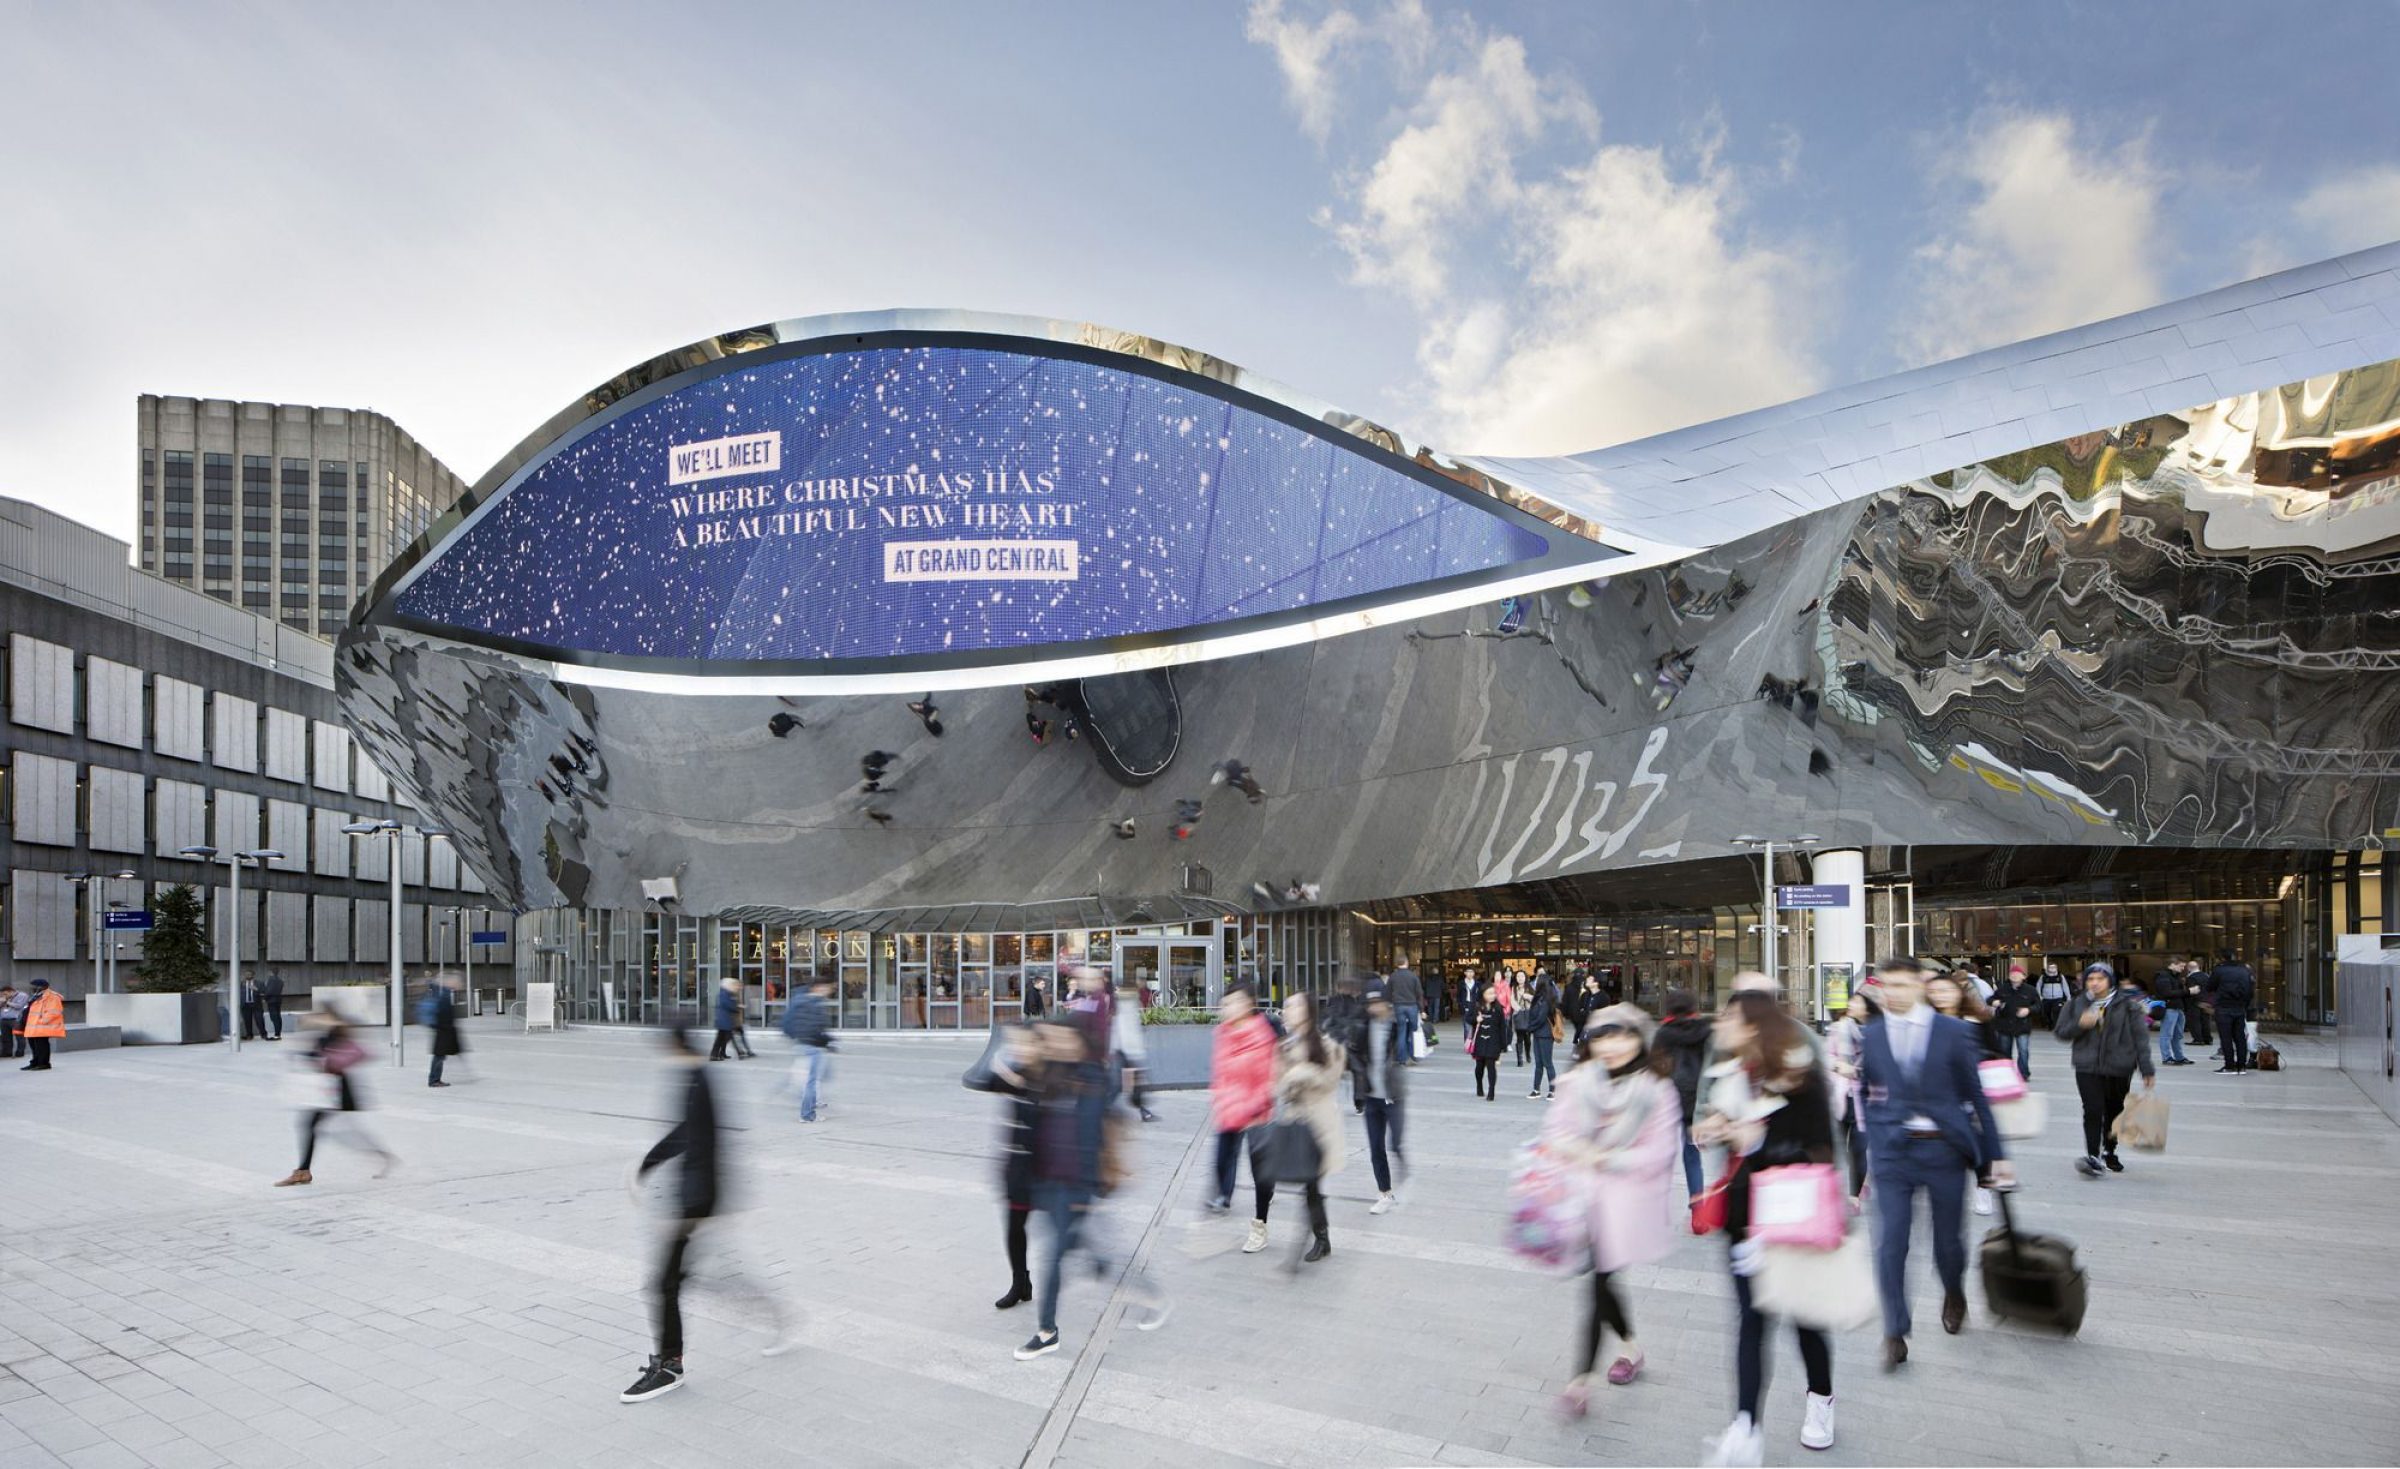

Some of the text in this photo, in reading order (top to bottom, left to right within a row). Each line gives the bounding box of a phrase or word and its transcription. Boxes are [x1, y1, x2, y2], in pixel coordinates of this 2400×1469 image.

[677, 440, 772, 476] WE'LL MEET
[670, 470, 1055, 519] WHERE CHRISTMAS HAS
[670, 503, 1078, 548] A BEAUTIFUL NEW HEART
[893, 547, 1069, 574] AT GRAND CENTRAL
